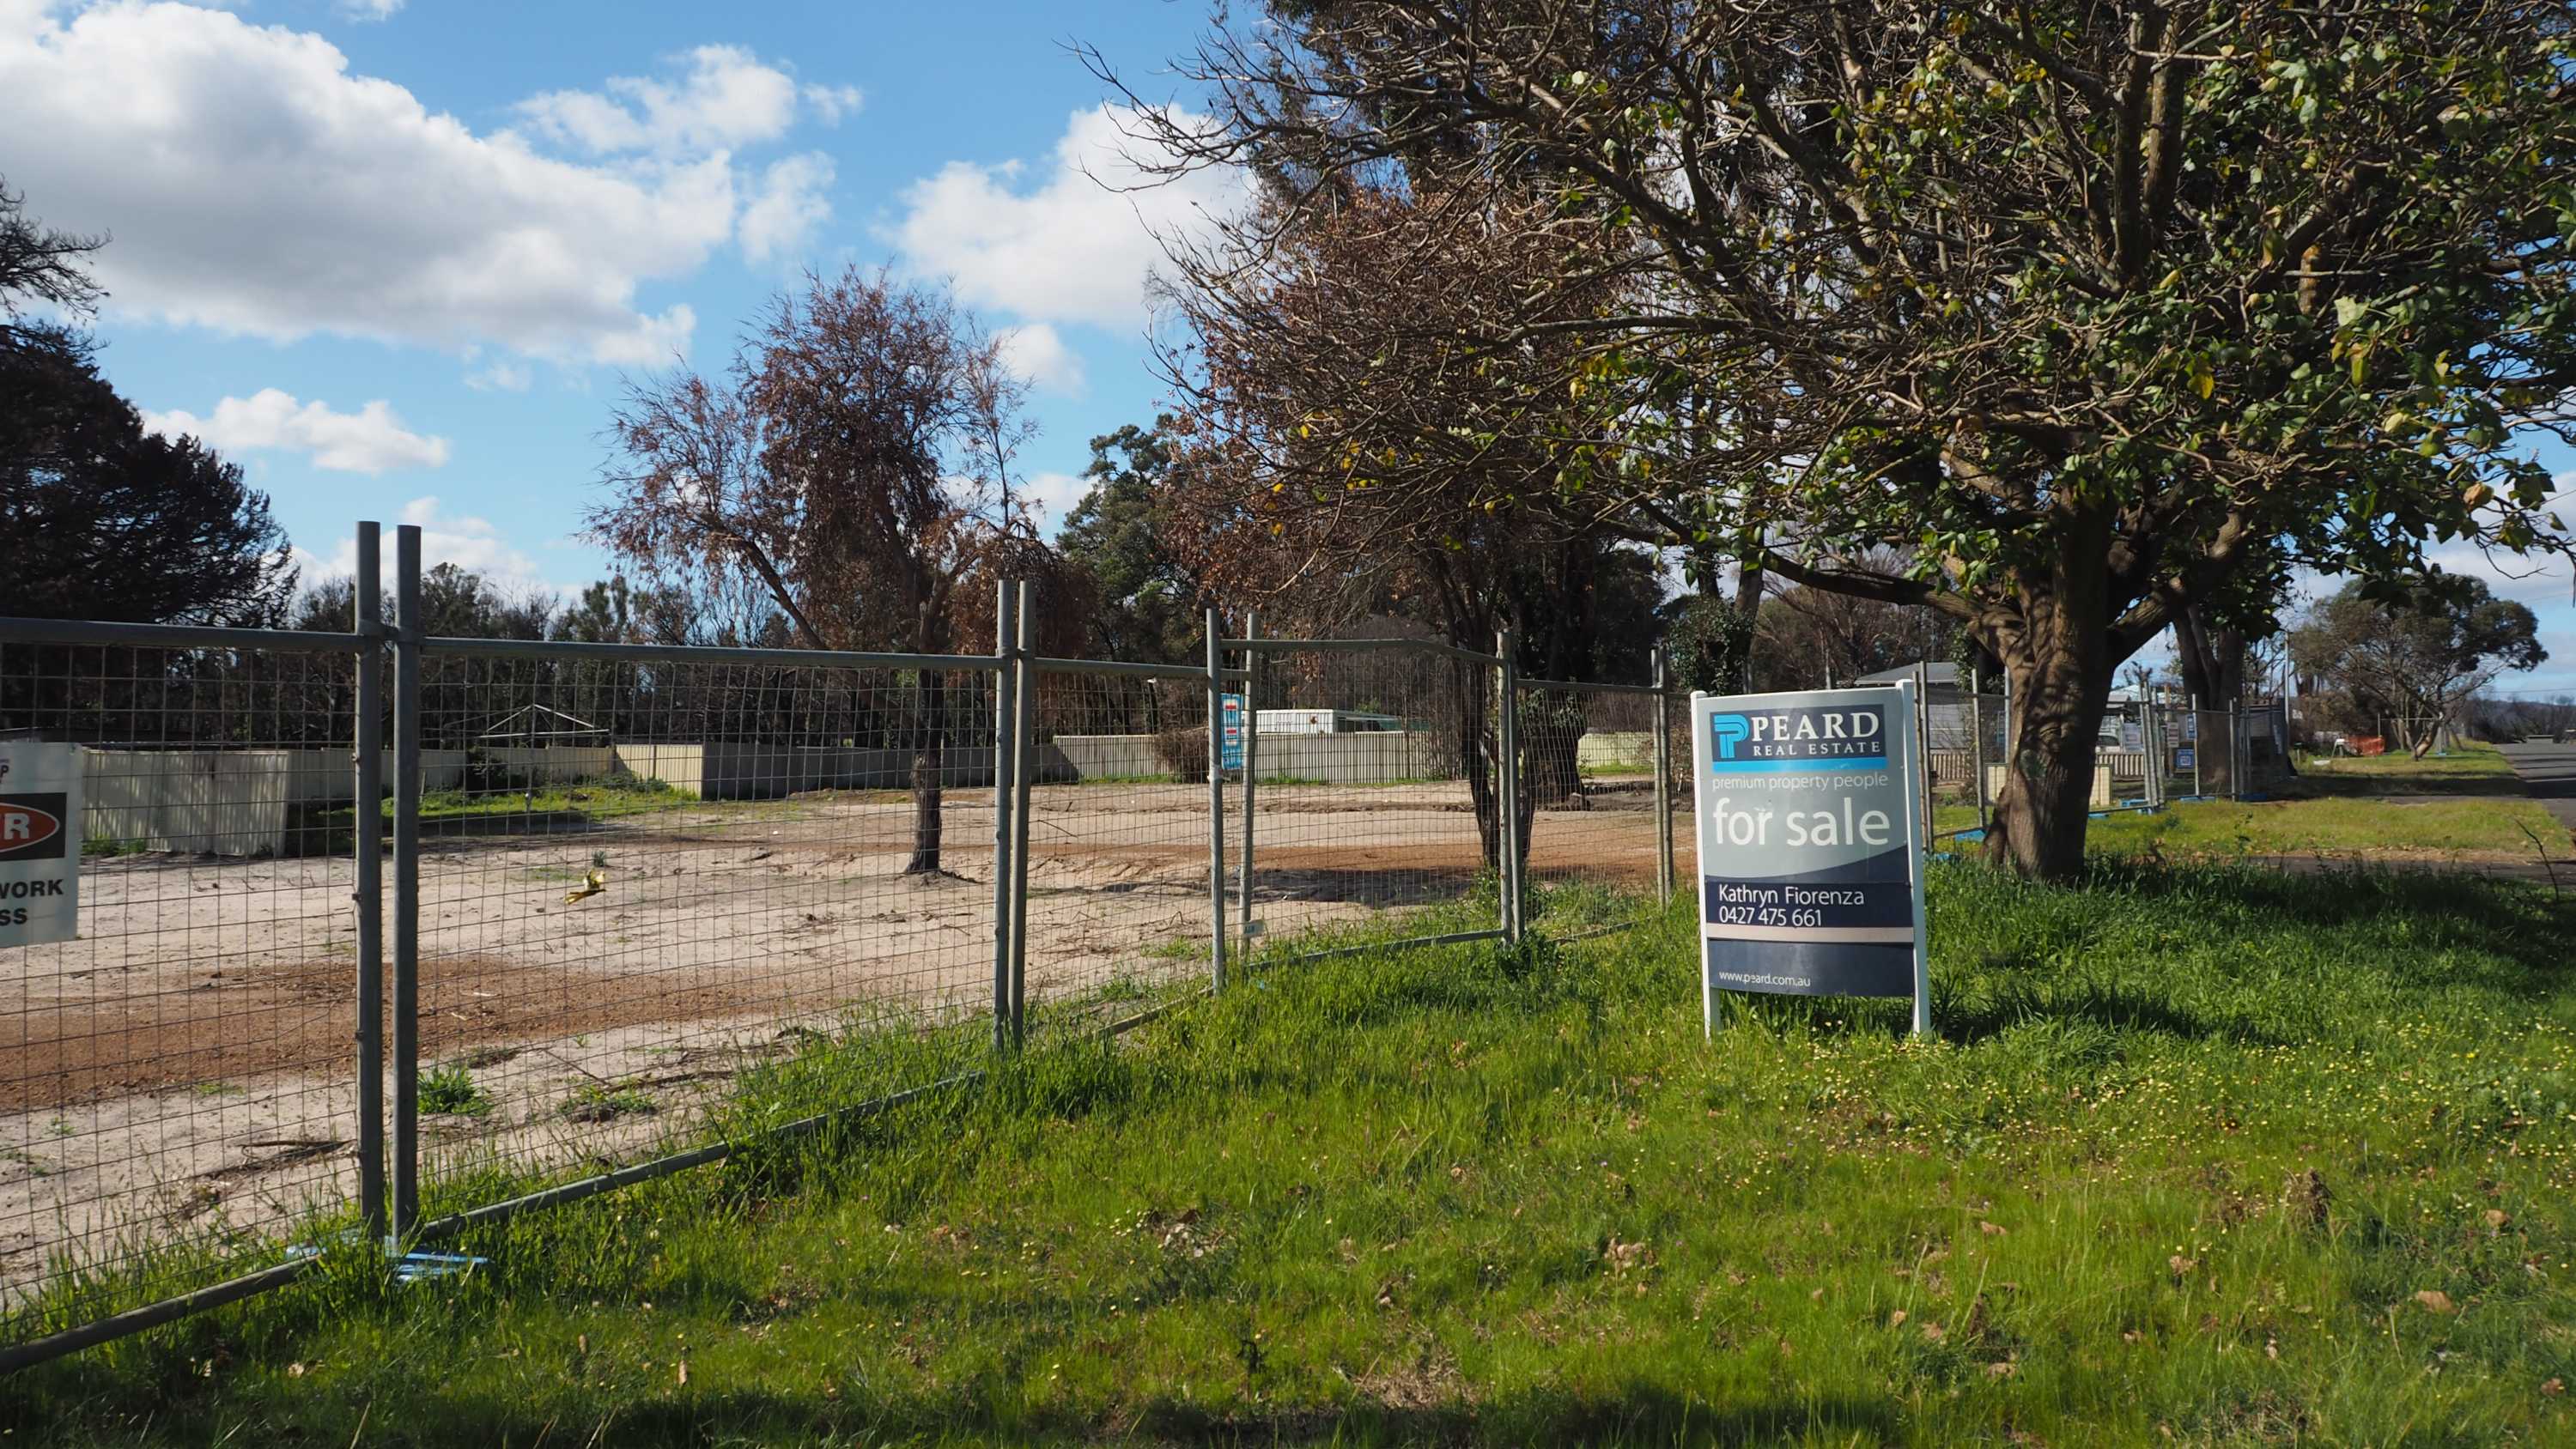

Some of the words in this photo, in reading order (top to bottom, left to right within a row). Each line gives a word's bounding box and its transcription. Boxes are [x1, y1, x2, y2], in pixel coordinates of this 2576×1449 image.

[1751, 712, 1880, 742] PEARD
[1753, 744, 1797, 756] REAL
[1808, 742, 1880, 755] ESTATE
[1712, 776, 1765, 791] premium
[1769, 776, 1829, 791] property
[1834, 773, 1889, 789] people
[1713, 797, 1773, 846] for
[1786, 797, 1890, 846] sale
[1719, 883, 1778, 908] Kathryn
[1785, 886, 1864, 905] Fiorenza
[1719, 906, 1754, 925] 0427
[1758, 907, 1787, 926] 475
[1791, 909, 1821, 927] 661
[1719, 971, 1811, 987] www.peard.com.au
